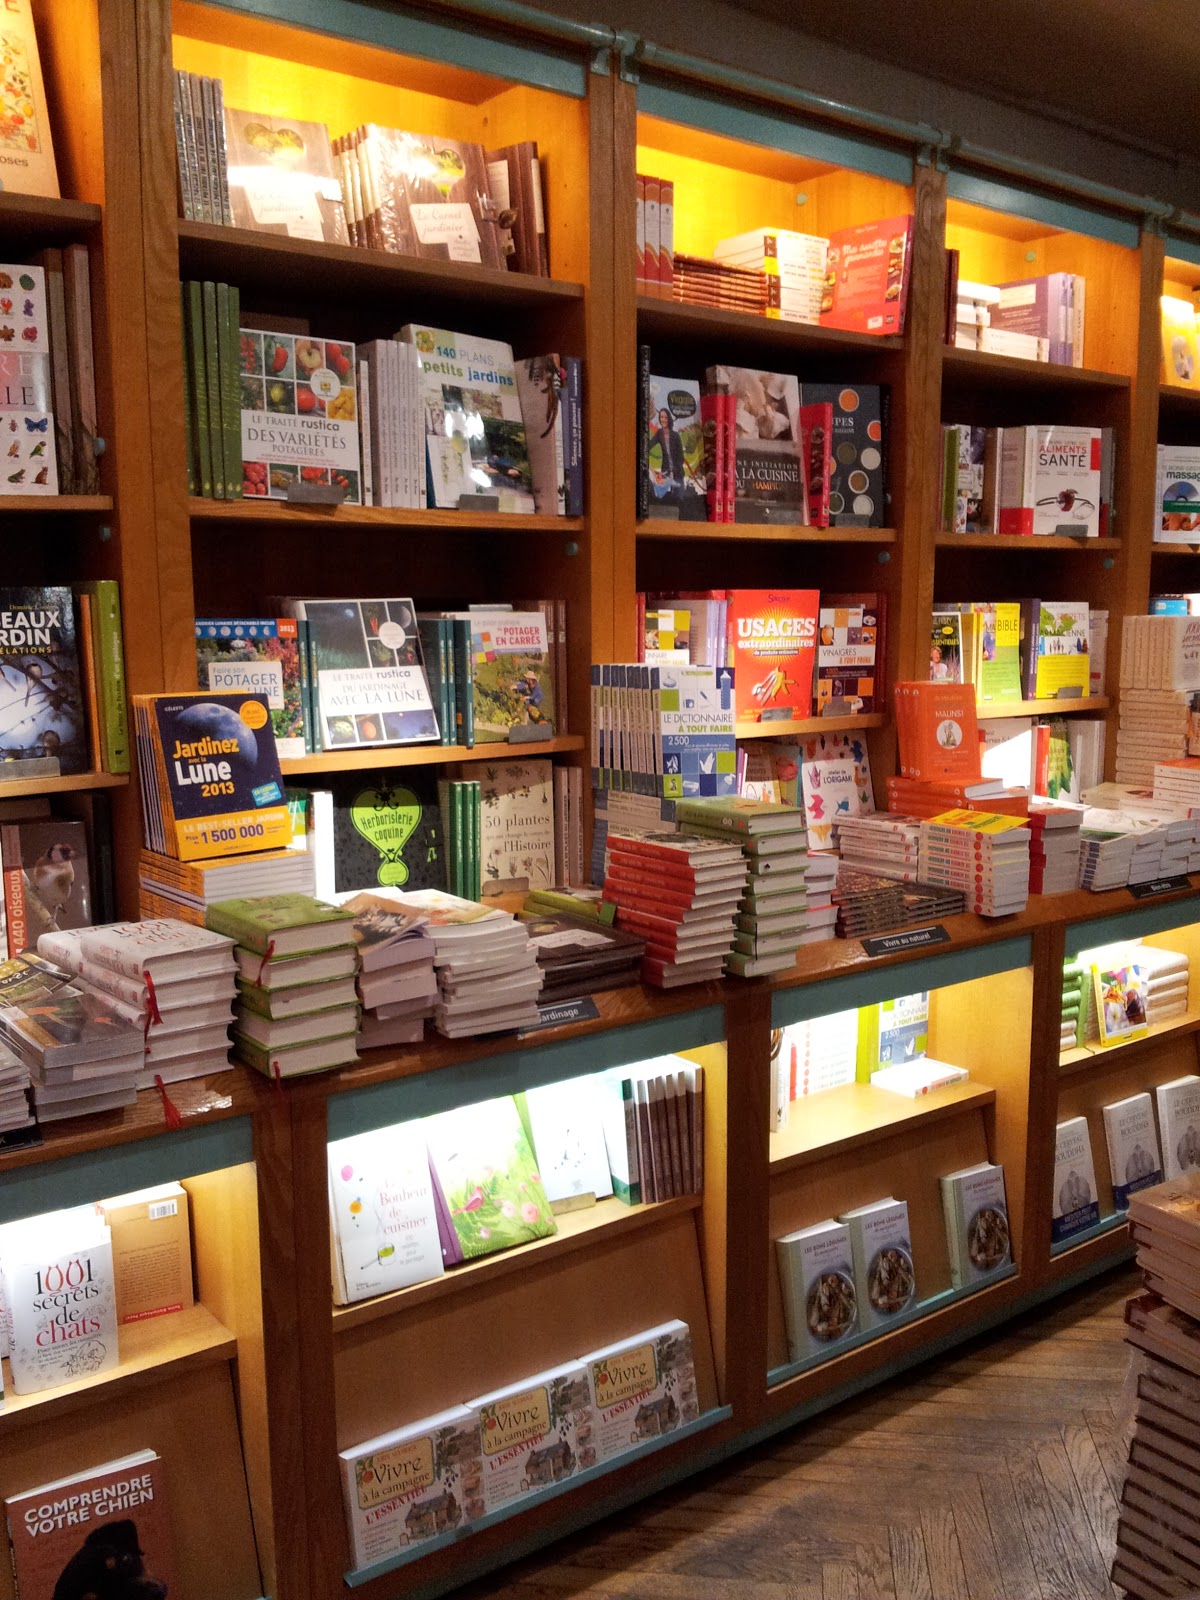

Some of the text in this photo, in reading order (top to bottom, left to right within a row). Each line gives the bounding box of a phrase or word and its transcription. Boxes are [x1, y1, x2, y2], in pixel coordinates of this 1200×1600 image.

[436, 346, 495, 366] 140 PLANS
[423, 360, 514, 387] petits jardins
[252, 414, 340, 432] LE TRAITÉ rustica
[247, 428, 347, 450] DES VARIÉTÉS
[1039, 445, 1087, 454] ALIMENTS
[1039, 453, 1087, 468] SANTÉ
[741, 469, 799, 482] LA CUISINE
[0, 611, 61, 628] EAUX
[737, 617, 816, 637] USAGES
[997, 619, 1018, 632] BIBLE
[280, 625, 294, 633] 2013
[503, 627, 540, 635] POTAGER
[495, 635, 541, 645] EN CARRÉS
[737, 637, 814, 649] extraordinaires
[822, 648, 857, 657] VINAIGRES
[214, 673, 278, 686] POTAGER
[376, 669, 411, 678] rustica
[330, 689, 425, 706] AVEC LA LUNE
[342, 685, 356, 693] DU
[664, 714, 733, 723] LE DICTIONNAIRE
[687, 725, 707, 733] TOUT
[710, 725, 733, 733] FAIRE
[173, 736, 240, 759] Jardinez
[174, 760, 232, 786] Lune
[201, 781, 235, 798] 2013
[183, 824, 196, 833] LE
[197, 817, 254, 832] BEST-SELLER
[360, 810, 414, 831] Herboristerie
[485, 813, 550, 829] 50 plantes
[374, 827, 404, 842] coquine
[503, 839, 551, 852] l'Histoire
[10, 869, 24, 946] 440 oiseaux
[883, 932, 930, 948] Vivre au naturel
[539, 1007, 579, 1023] ardinage
[389, 1206, 401, 1218] de
[384, 1216, 428, 1234] cuisiner
[33, 1284, 99, 1313] secrets
[55, 1306, 80, 1327] de
[36, 1315, 101, 1347] chats
[607, 1362, 648, 1386] Vivre
[606, 1388, 615, 1399] la
[616, 1376, 654, 1397] campagne
[496, 1405, 540, 1431] Vivre
[494, 1434, 503, 1446] la
[504, 1421, 547, 1442] campagne
[373, 1456, 424, 1484] Vivre
[370, 1488, 380, 1498] la
[381, 1471, 430, 1496] campagne
[24, 1474, 153, 1523] COMPRENDRE
[366, 1485, 428, 1525] L'ESSENTIEL
[26, 1488, 154, 1538] VOTRE CHIEN
